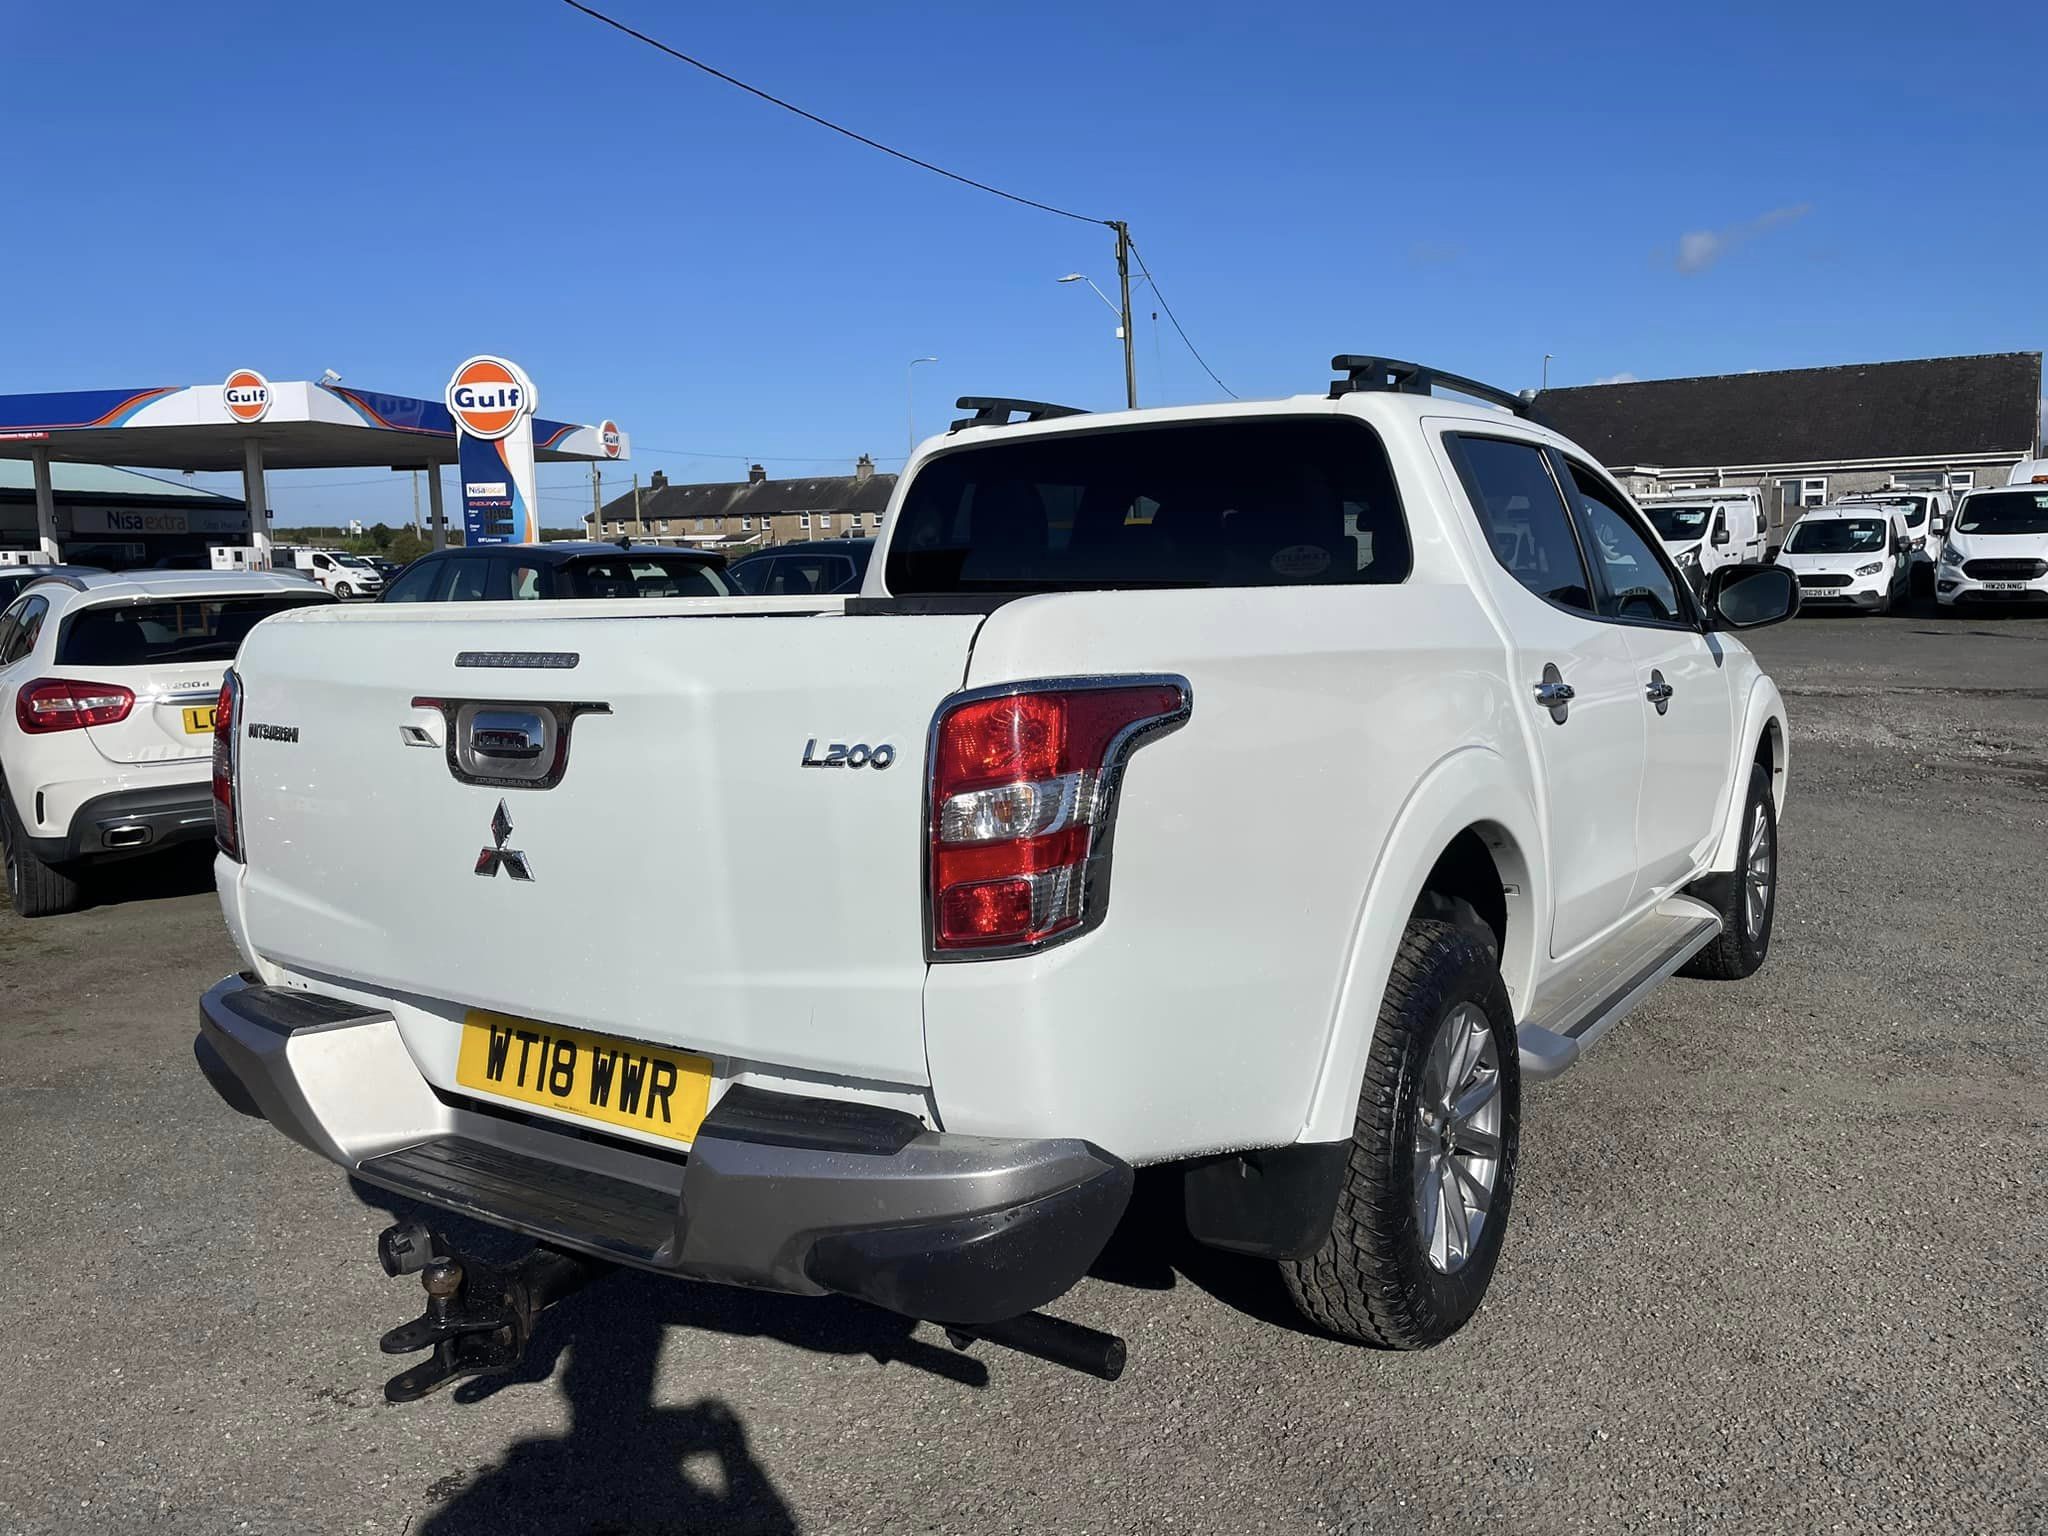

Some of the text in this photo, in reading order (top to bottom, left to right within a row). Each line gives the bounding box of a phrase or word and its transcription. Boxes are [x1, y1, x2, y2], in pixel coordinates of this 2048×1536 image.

[226, 390, 265, 402] Gulf
[454, 387, 519, 408] Gulf
[603, 433, 620, 444] Gulf
[801, 738, 897, 770] L200
[486, 1024, 678, 1123] WT18 WWR
